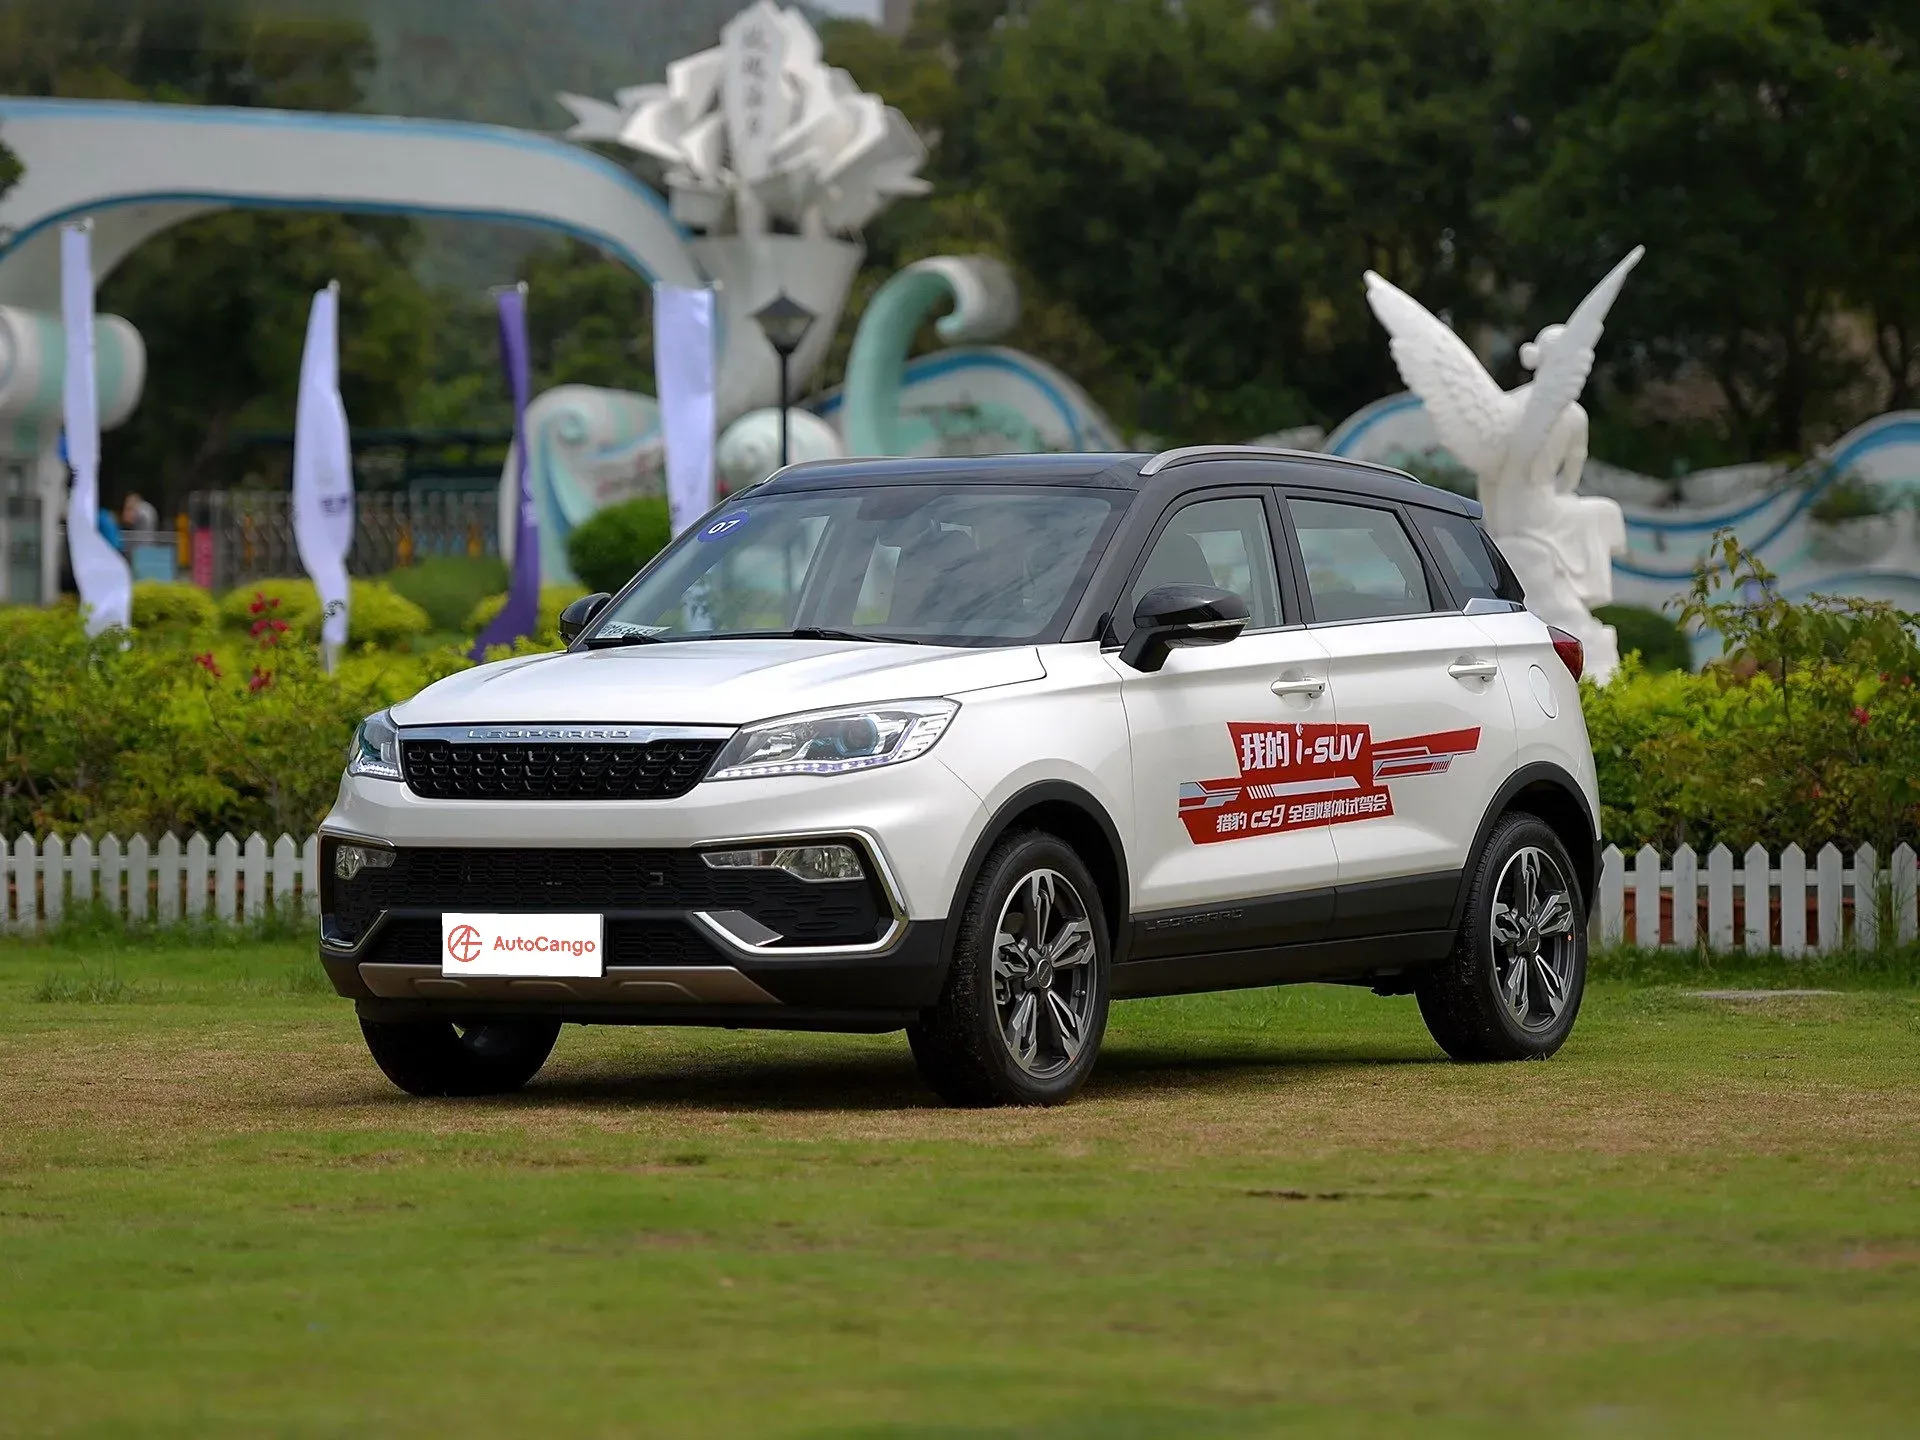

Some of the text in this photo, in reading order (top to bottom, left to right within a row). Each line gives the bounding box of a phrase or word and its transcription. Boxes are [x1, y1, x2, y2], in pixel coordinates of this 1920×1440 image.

[707, 519, 741, 535] 07
[1240, 731, 1290, 771] 我的
[1216, 811, 1248, 833] 猎豹
[1287, 794, 1388, 824] 全国媒体试驾会
